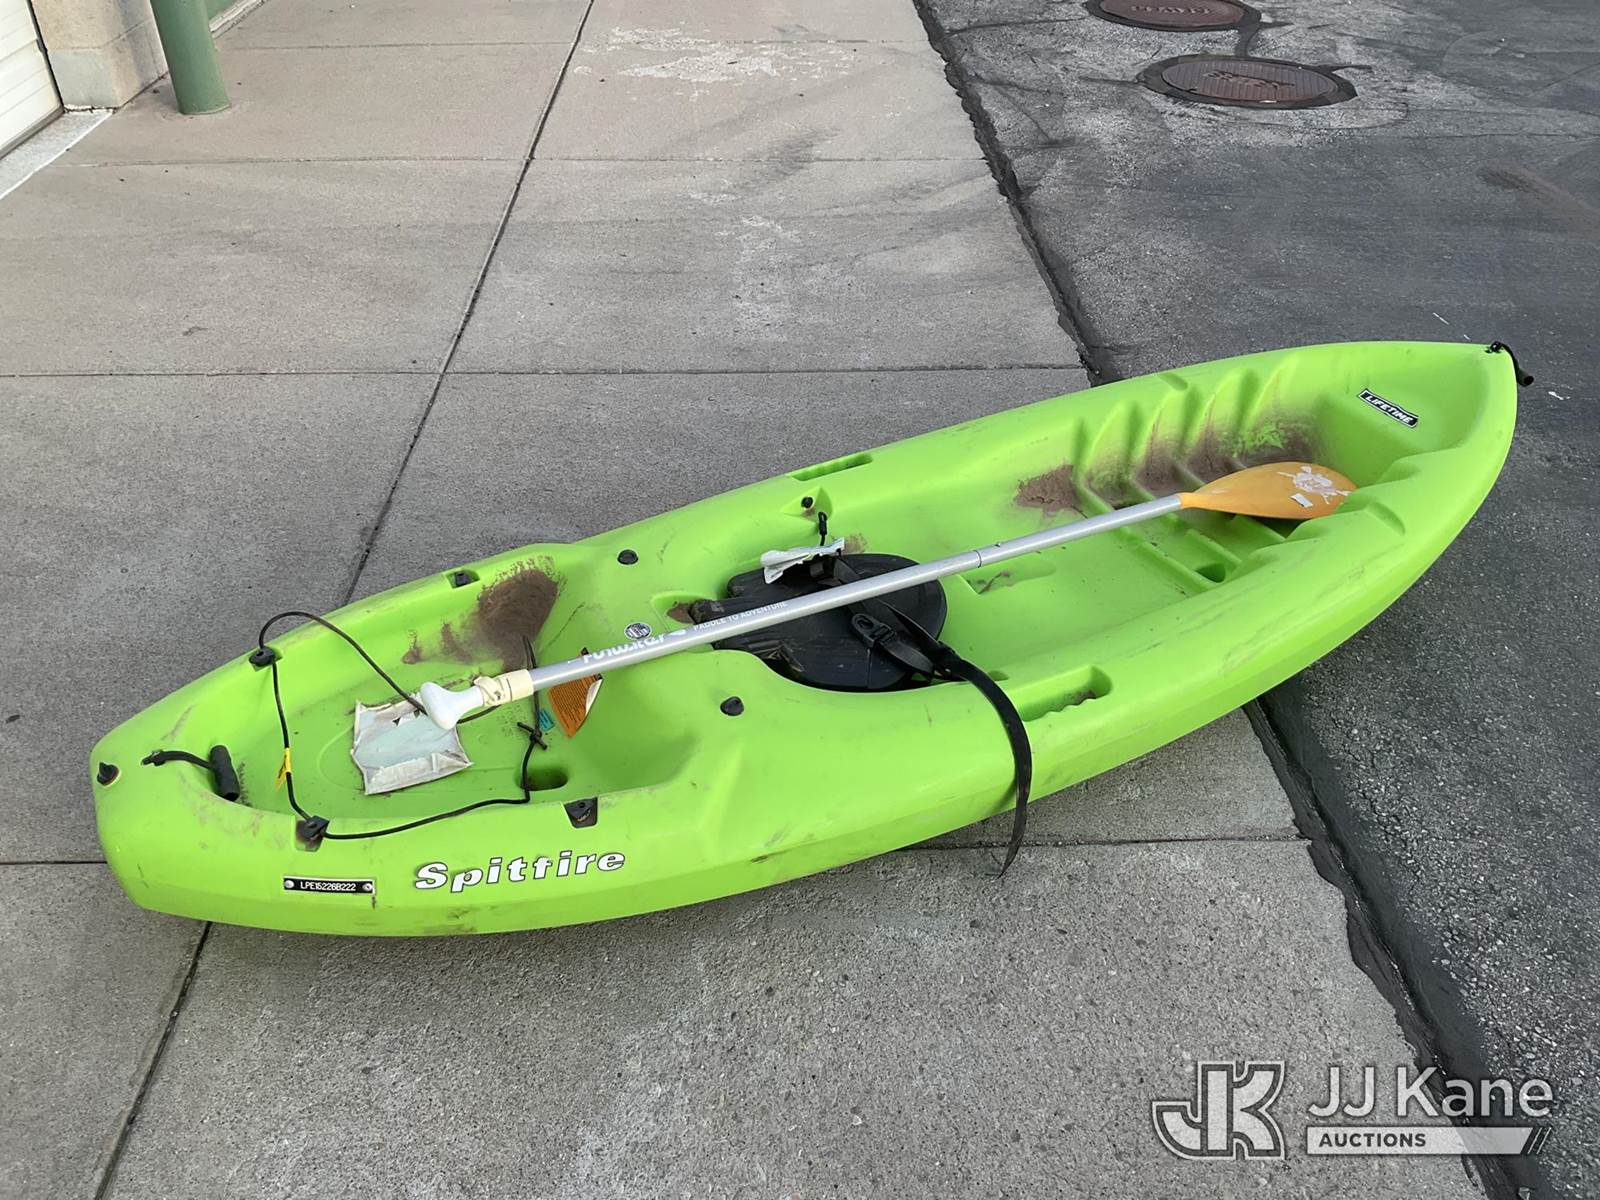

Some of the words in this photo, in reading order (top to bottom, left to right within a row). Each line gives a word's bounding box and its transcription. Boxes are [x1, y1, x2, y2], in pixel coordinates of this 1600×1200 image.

[1365, 395, 1414, 423] LIFETIME
[741, 601, 788, 618] ADVENTURE
[415, 850, 626, 893] Spitfire
